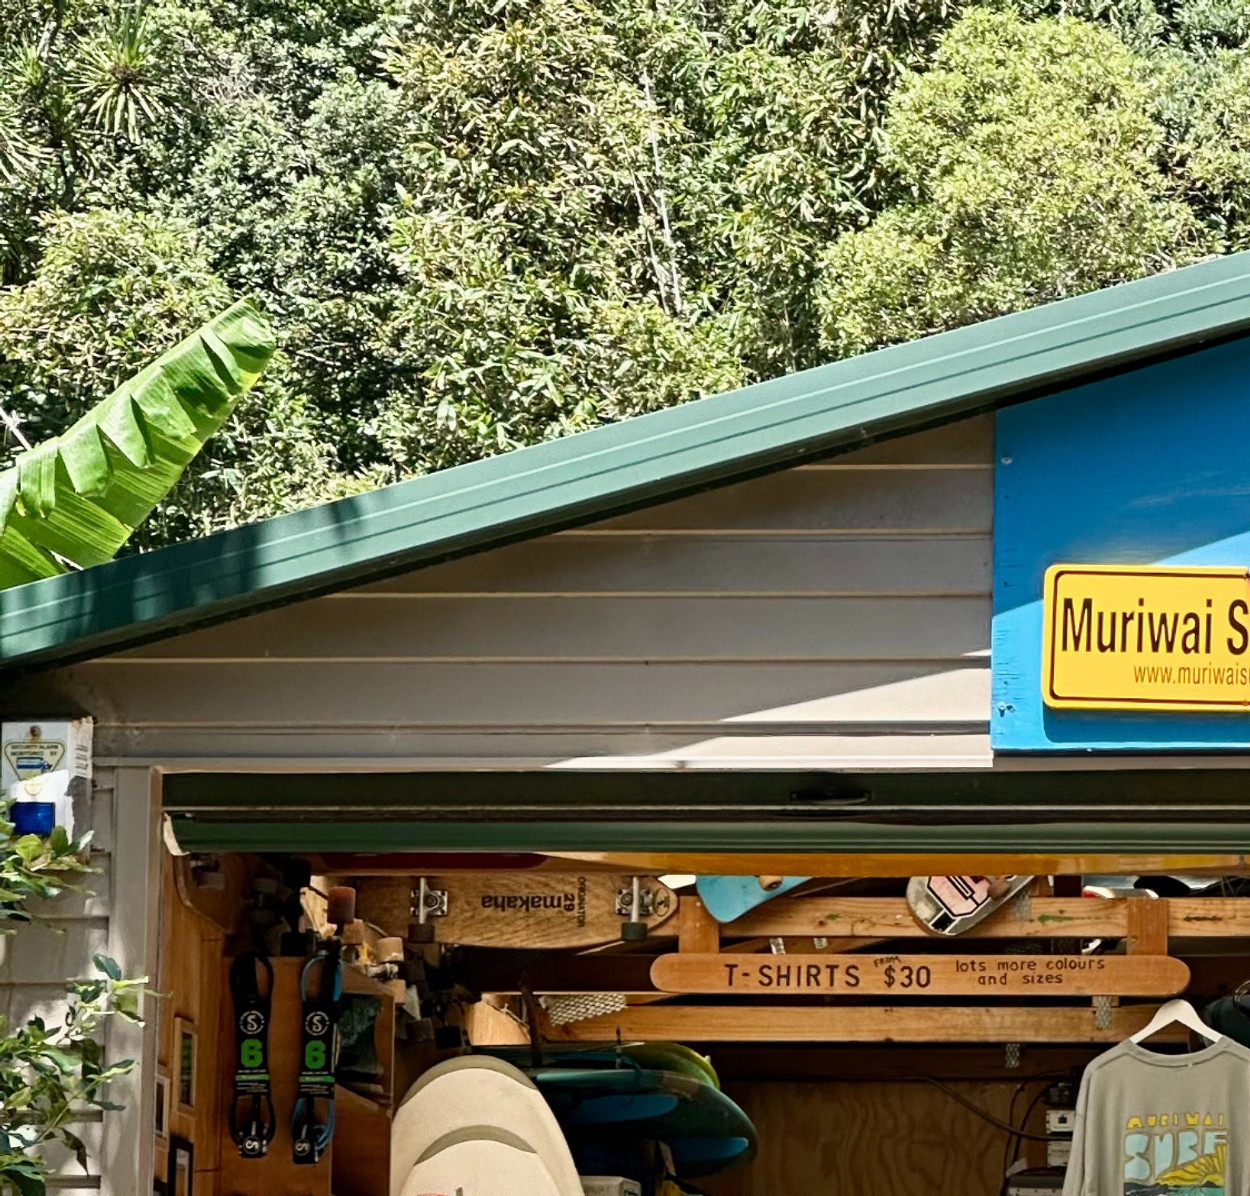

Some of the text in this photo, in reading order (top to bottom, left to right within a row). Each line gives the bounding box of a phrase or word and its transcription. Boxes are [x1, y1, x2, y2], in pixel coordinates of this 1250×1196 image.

[1061, 597, 1212, 655] Muriwai
[481, 894, 562, 913] makaha
[563, 893, 575, 913] 29
[723, 955, 931, 988] T-SHIRTS FROM $30
[955, 957, 1106, 973] lots more colours
[977, 972, 1064, 986] and sizes
[240, 1038, 263, 1068] 6
[304, 1039, 326, 1070] 6
[1124, 1131, 1228, 1181] SURF
